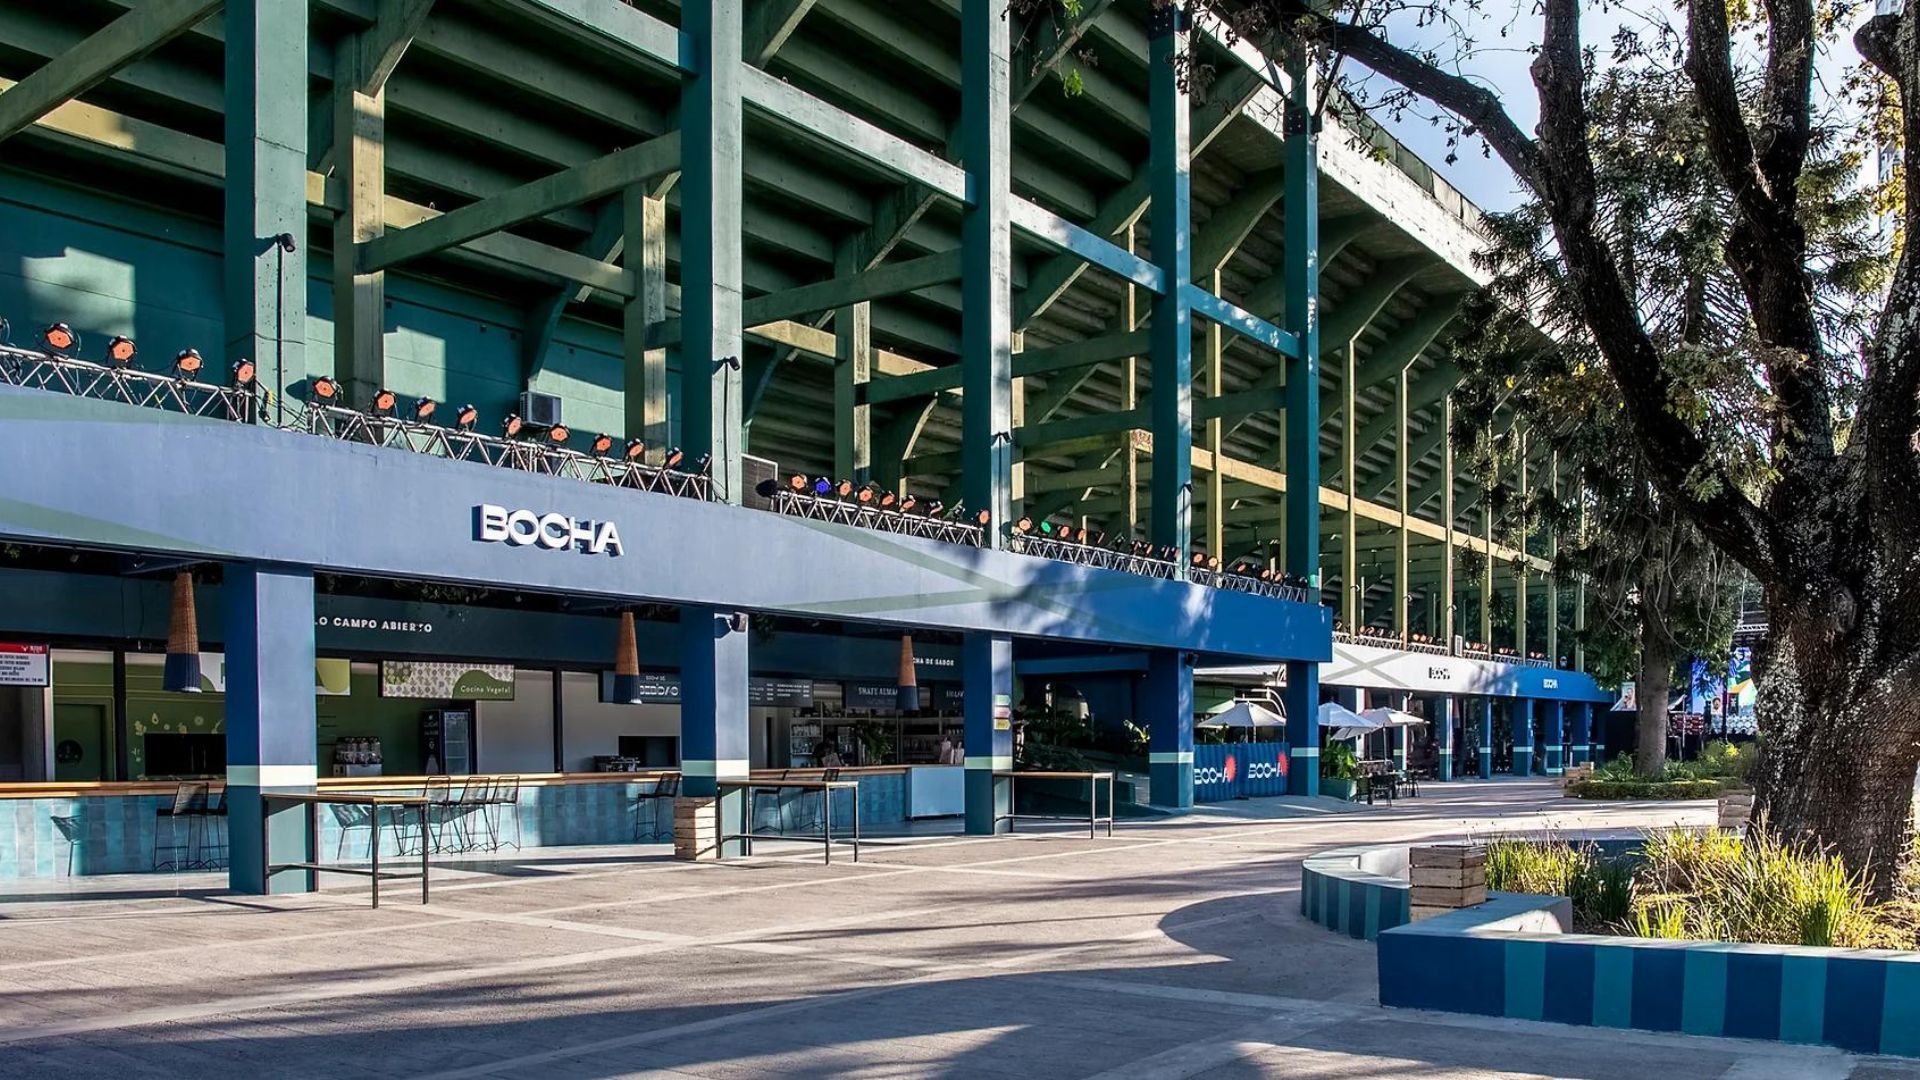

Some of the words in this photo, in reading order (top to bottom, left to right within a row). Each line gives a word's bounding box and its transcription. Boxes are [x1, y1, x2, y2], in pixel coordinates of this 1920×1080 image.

[473, 503, 624, 556] BOCHA
[315, 616, 328, 626] O
[333, 617, 377, 629] CAMPO
[381, 621, 433, 632] ABIERTO
[460, 685, 482, 694] Cocina
[485, 686, 511, 695] Vegetal
[1193, 767, 1231, 785] BOCHA
[1247, 762, 1284, 779] BOCHA
